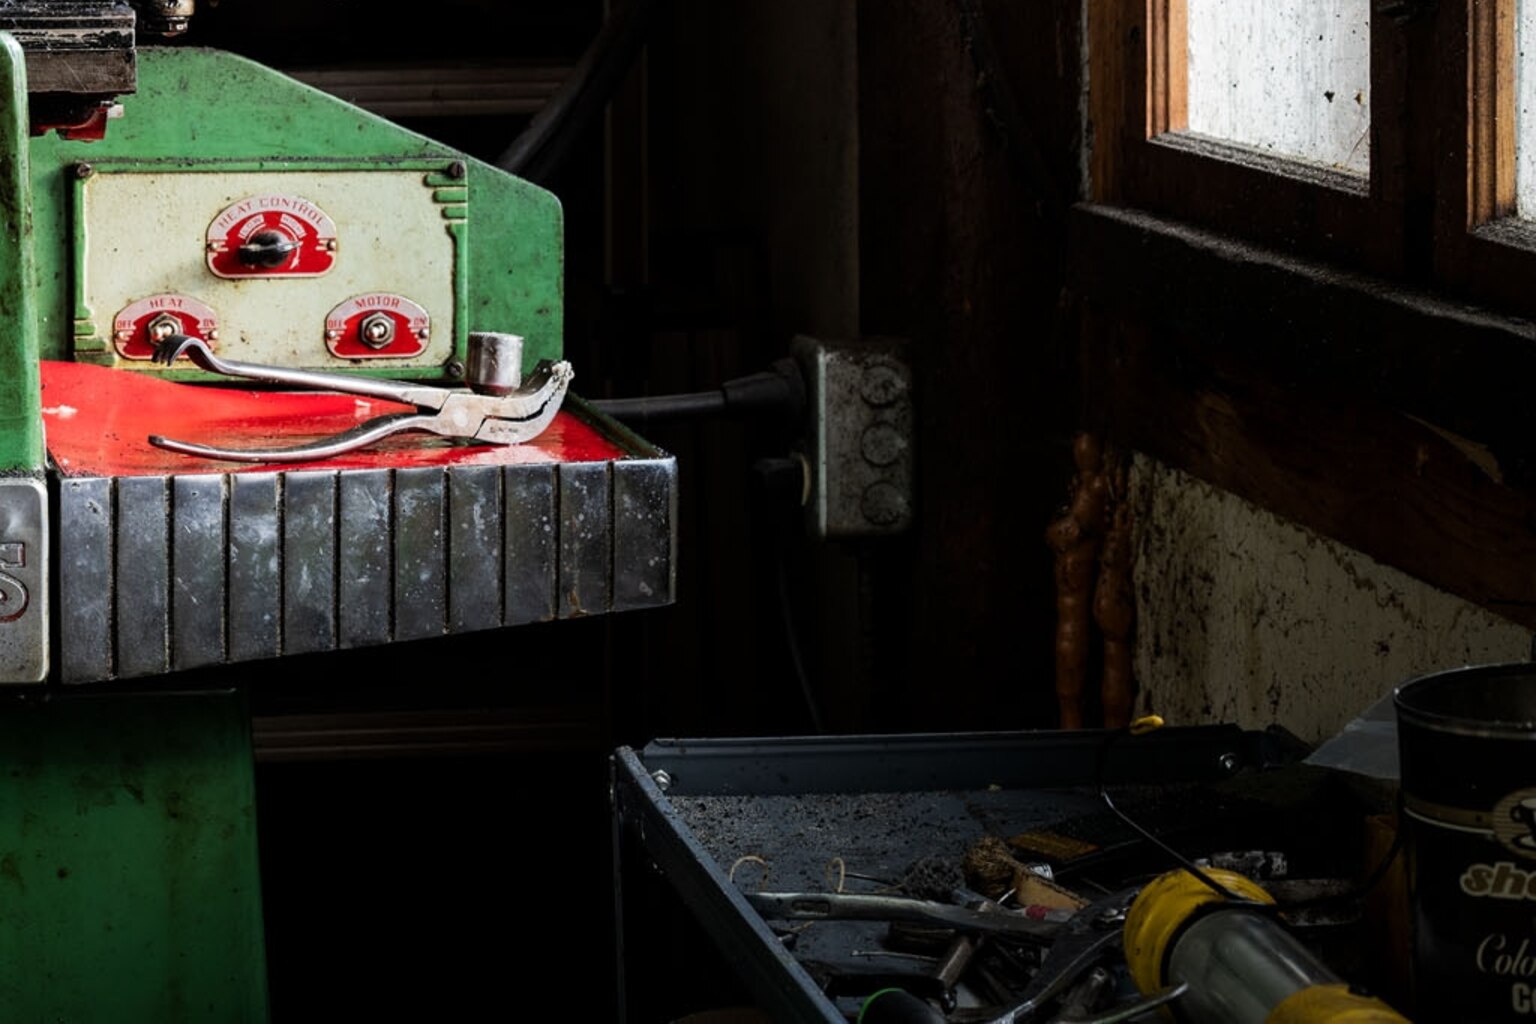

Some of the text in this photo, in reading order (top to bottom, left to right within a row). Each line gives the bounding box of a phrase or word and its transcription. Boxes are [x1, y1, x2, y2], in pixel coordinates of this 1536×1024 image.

[218, 197, 324, 229] HEAT CONTROL
[149, 298, 183, 308] HEAT
[355, 296, 401, 308] MOTOR
[117, 319, 133, 329] OFF
[328, 319, 344, 329] OFF
